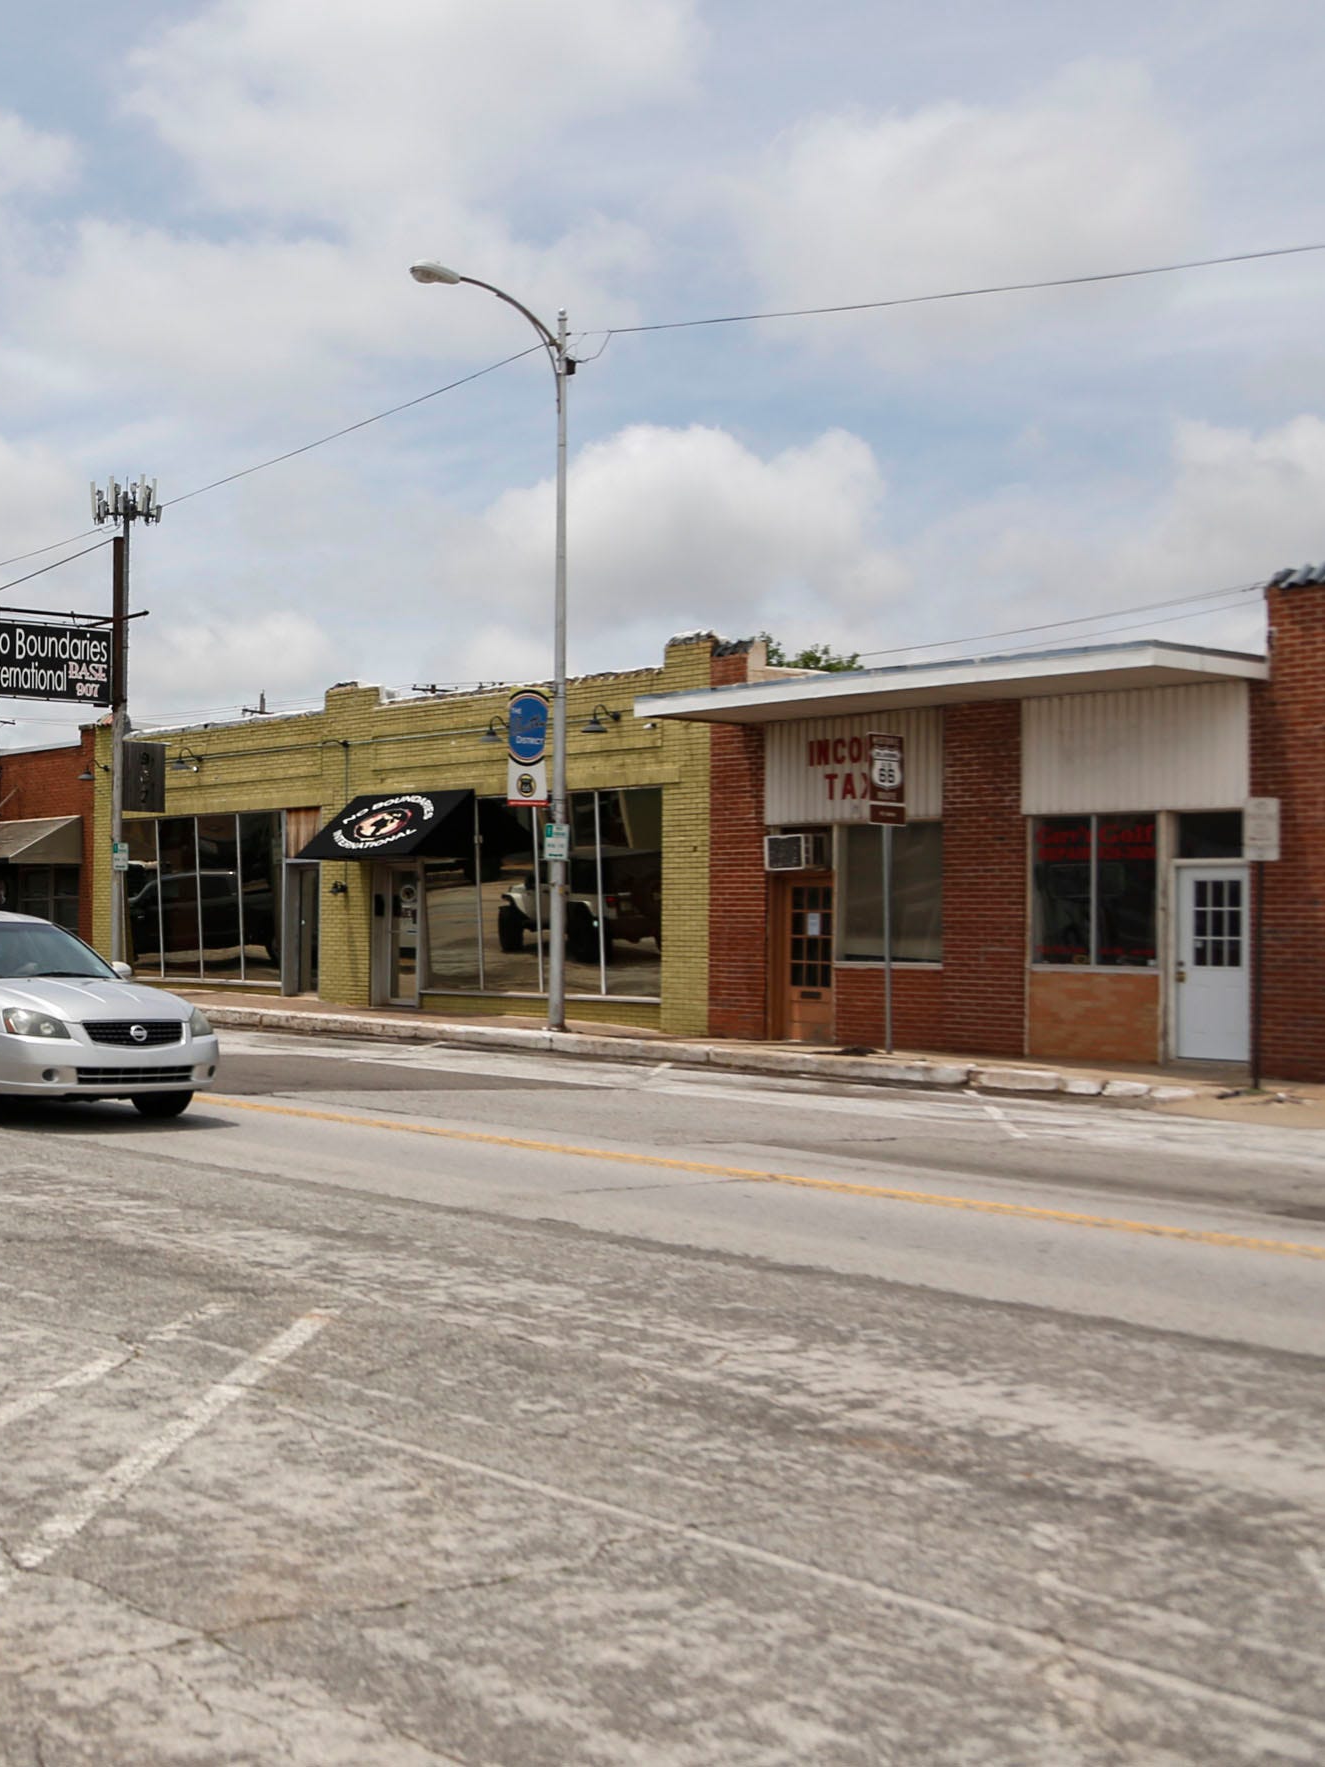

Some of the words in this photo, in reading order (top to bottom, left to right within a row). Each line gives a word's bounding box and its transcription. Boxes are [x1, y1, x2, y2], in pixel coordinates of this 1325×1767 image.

[15, 628, 108, 662] Boundaries
[68, 661, 107, 682] BASE
[76, 683, 100, 697] 907
[807, 737, 871, 767] INCO
[879, 767, 895, 784] 66
[342, 808, 369, 825] NO
